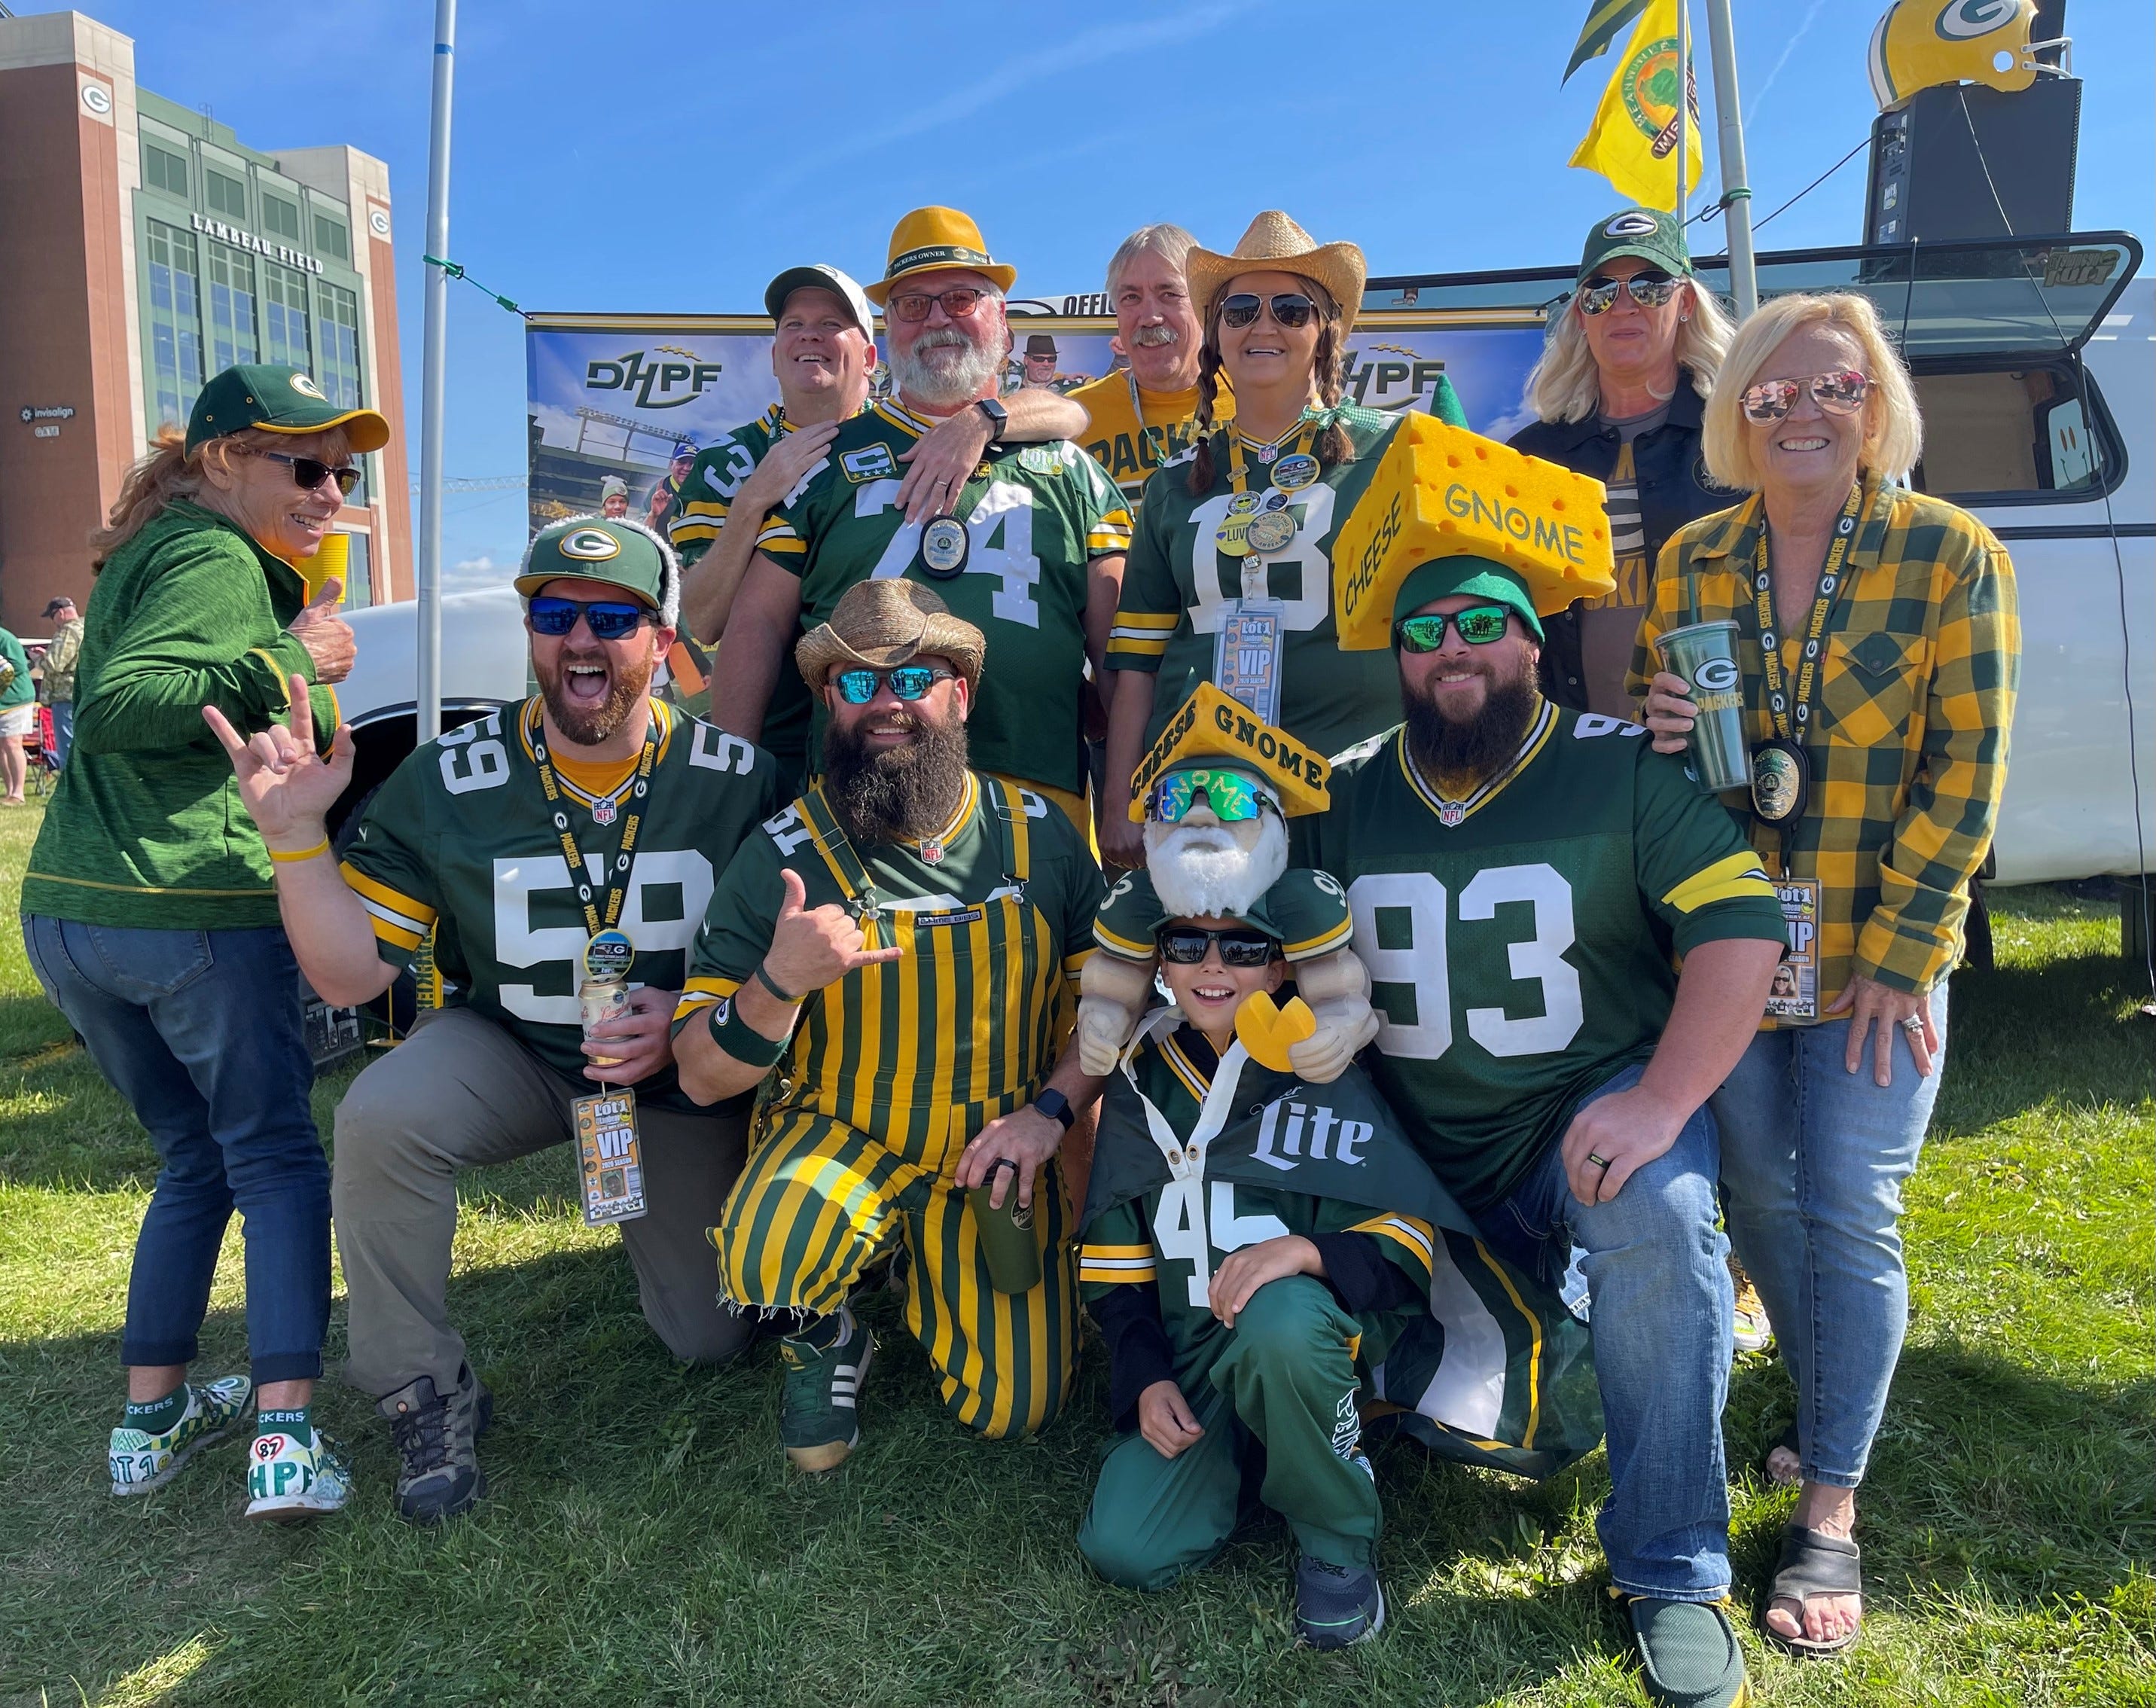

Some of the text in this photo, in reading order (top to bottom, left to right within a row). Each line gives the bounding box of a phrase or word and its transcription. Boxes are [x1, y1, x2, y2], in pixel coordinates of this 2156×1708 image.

[1654, 120, 1679, 154] WIS
[191, 212, 325, 275] LAMBEAU FIELD
[893, 255, 918, 270] PACKERS
[918, 249, 946, 260] OWNER
[1337, 350, 1446, 410] HPF
[35, 407, 74, 419] invisalign
[1085, 419, 1219, 478] PACK
[1445, 483, 1585, 565] GNOME
[1187, 482, 1337, 635] 18
[1345, 492, 1402, 616] CHEESE
[1755, 534, 1768, 572] PACKERS
[1825, 537, 1849, 575] PACKERS
[1757, 590, 1773, 630] PACKERS
[1809, 598, 1830, 639] PACKERS
[1238, 648, 1272, 676] VIP
[1764, 650, 1782, 691] PACKERS
[1797, 661, 1815, 703] PACKERS
[1696, 691, 1744, 714] PACKERS
[639, 740, 655, 778] PACKERS
[1130, 699, 1197, 801] CHEESE
[1215, 704, 1322, 791] GNOME
[1157, 770, 1252, 821] GNOME
[538, 764, 560, 801] PACKERS
[560, 831, 582, 869] PACKERS
[596, 808, 614, 822] NFL
[620, 813, 640, 851] PACKERS
[1442, 808, 1464, 825] NFL
[924, 848, 942, 862] NFL
[604, 887, 623, 924] PACKERS
[919, 912, 980, 926] GAME BIBS
[1346, 863, 1584, 1060] 93
[596, 1128, 634, 1160] VIP
[1248, 1098, 1374, 1171] Lite
[258, 1411, 306, 1423] CKERS
[259, 1441, 279, 1458] 87
[109, 1456, 135, 1484] OT
